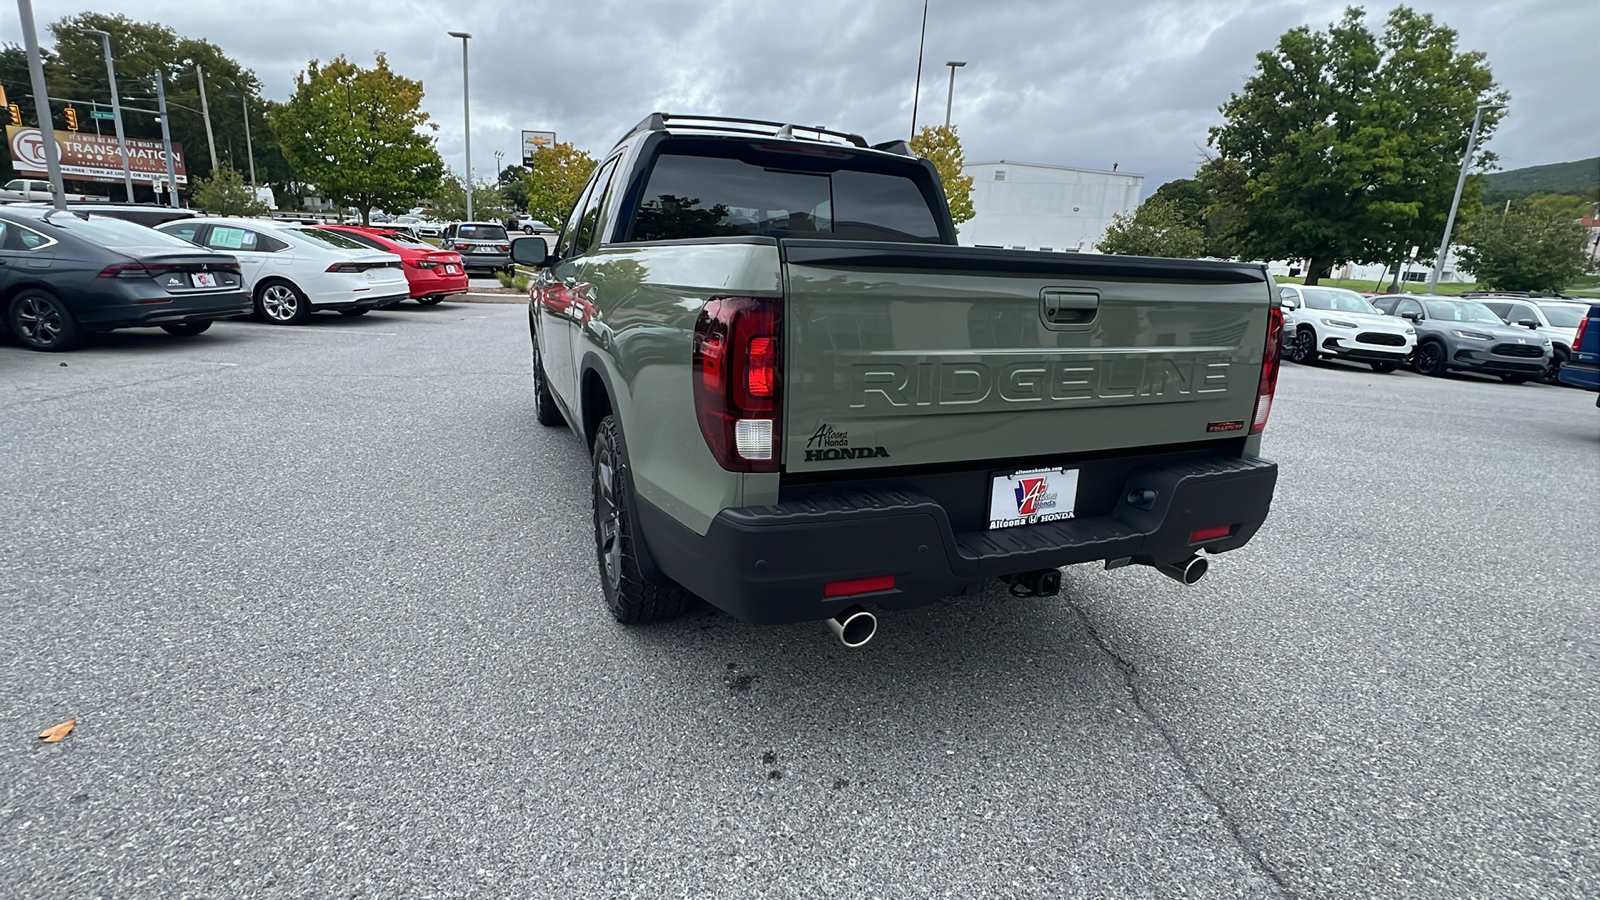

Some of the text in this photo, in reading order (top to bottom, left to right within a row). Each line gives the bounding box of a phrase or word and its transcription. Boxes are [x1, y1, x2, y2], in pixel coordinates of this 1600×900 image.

[850, 358, 1231, 408] RIDGELINE
[824, 438, 848, 448] Honda
[804, 446, 890, 462] HONDA
[989, 511, 1075, 530] Altoona HONDA
